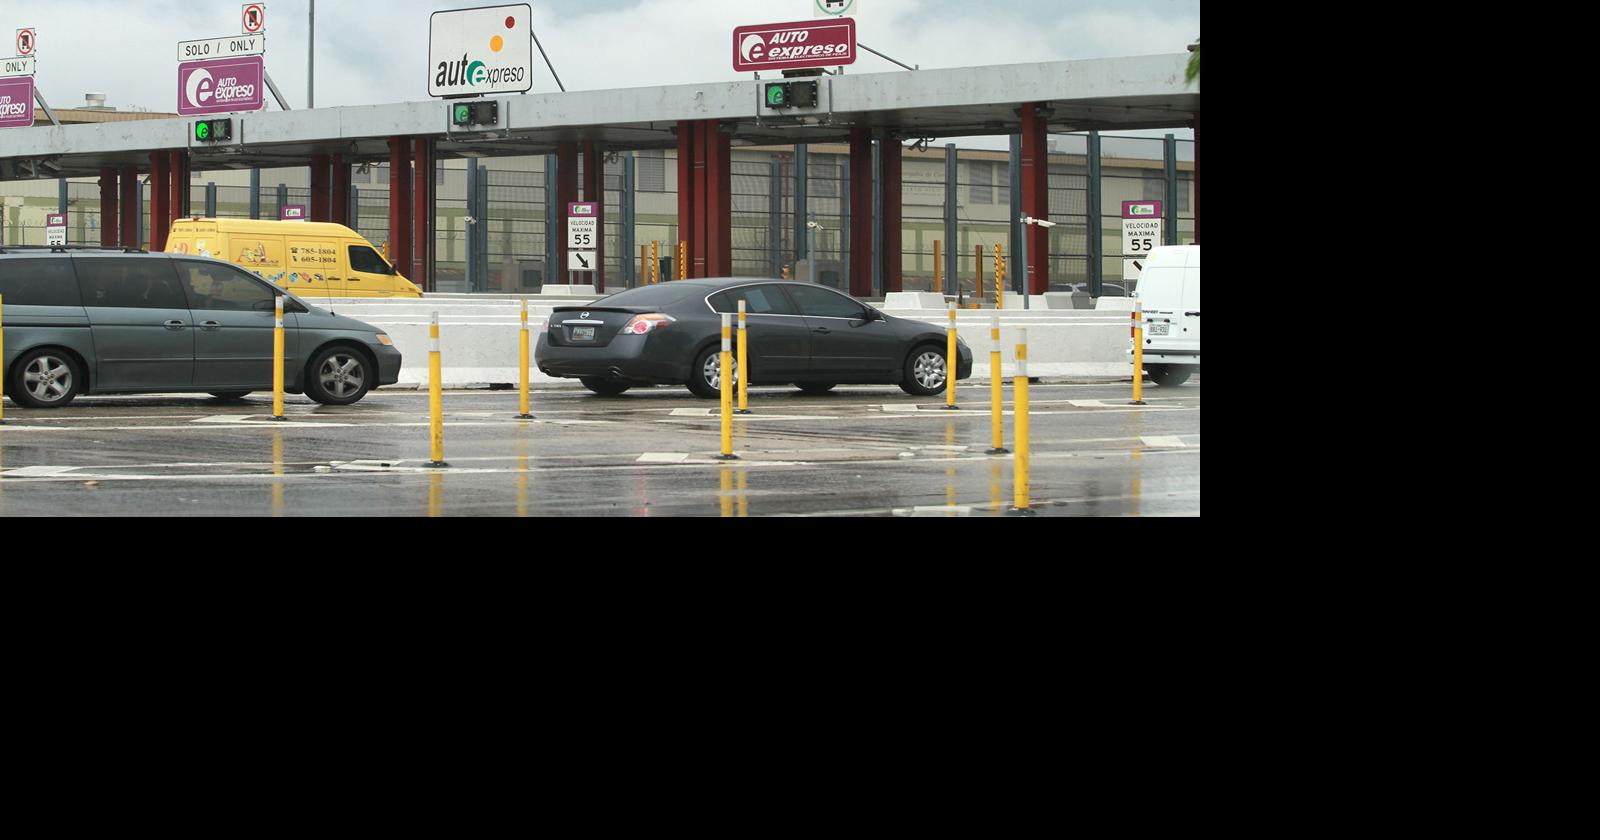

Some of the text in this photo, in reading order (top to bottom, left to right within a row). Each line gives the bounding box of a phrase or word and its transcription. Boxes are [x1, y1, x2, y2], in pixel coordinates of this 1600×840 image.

[768, 30, 809, 45] AUTO
[185, 43, 210, 56] SOLO
[229, 39, 255, 52] ONLY
[768, 43, 848, 58] expreso
[5, 60, 28, 73] ONLY
[217, 77, 237, 87] AUTO
[215, 84, 254, 101] expreso
[574, 234, 590, 245] 55
[1131, 239, 1153, 251] 55
